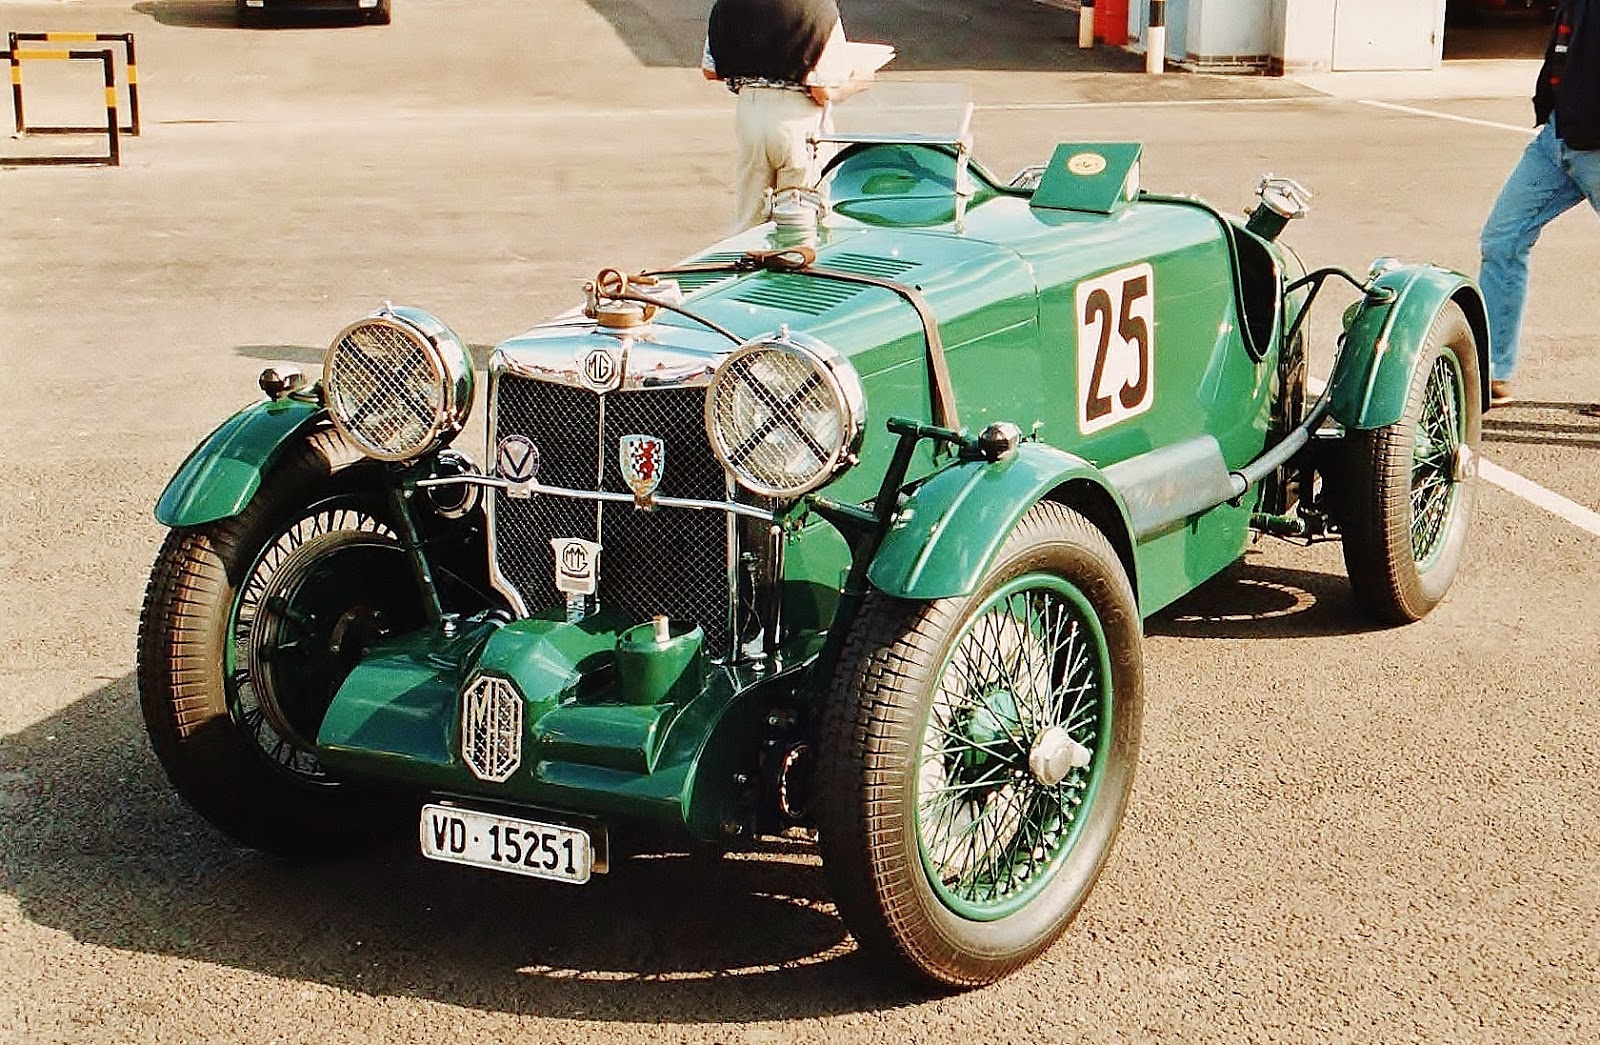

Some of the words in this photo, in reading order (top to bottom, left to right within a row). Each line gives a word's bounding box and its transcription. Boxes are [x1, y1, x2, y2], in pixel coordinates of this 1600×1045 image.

[587, 353, 610, 380] MG
[1084, 274, 1149, 422] 25
[469, 679, 517, 779] MG
[432, 814, 466, 854] VD
[488, 825, 576, 874] 15251
